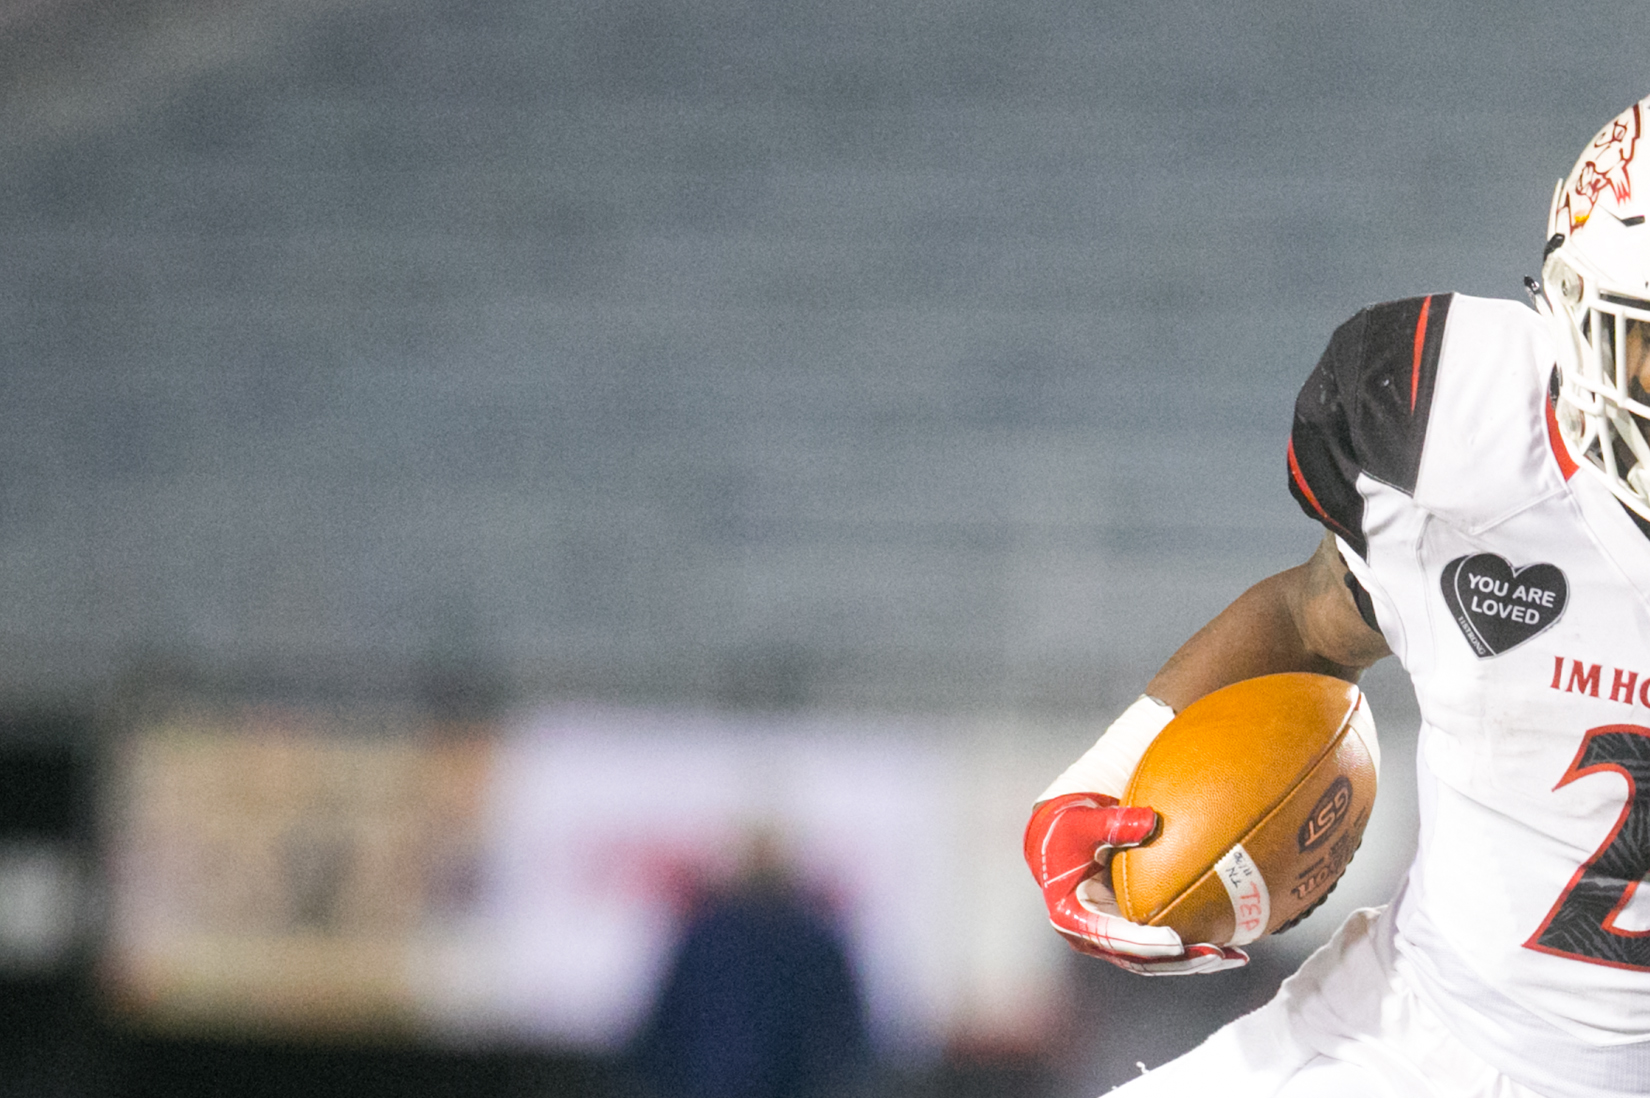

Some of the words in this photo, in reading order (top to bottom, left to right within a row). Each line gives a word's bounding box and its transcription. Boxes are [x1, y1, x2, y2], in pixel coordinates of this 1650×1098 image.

[1468, 572, 1509, 597] YOU
[1512, 585, 1556, 608] ARE
[1471, 596, 1540, 625] LOVED
[1304, 786, 1349, 847] GST
[1239, 881, 1262, 931] TEP
